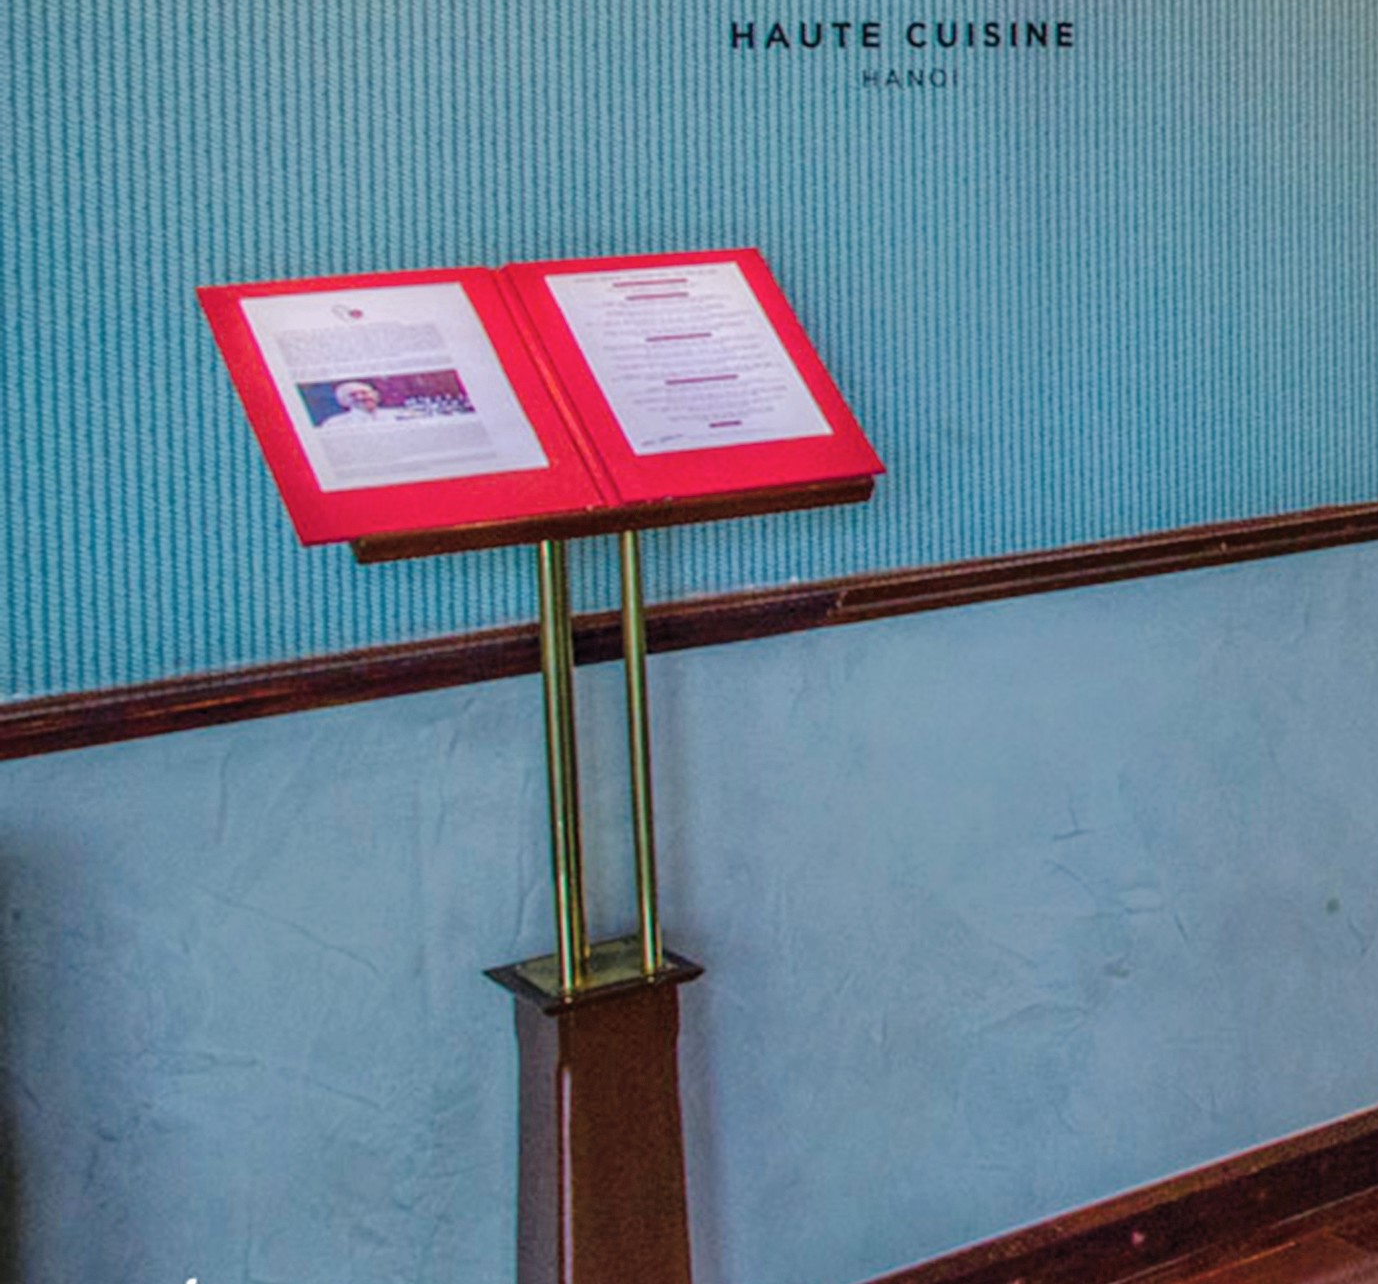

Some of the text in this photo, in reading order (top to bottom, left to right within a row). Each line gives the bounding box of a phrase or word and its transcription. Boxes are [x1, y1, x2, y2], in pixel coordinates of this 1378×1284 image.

[730, 21, 1075, 49] HAUTE CUISINE
[861, 68, 959, 89] HANOI
